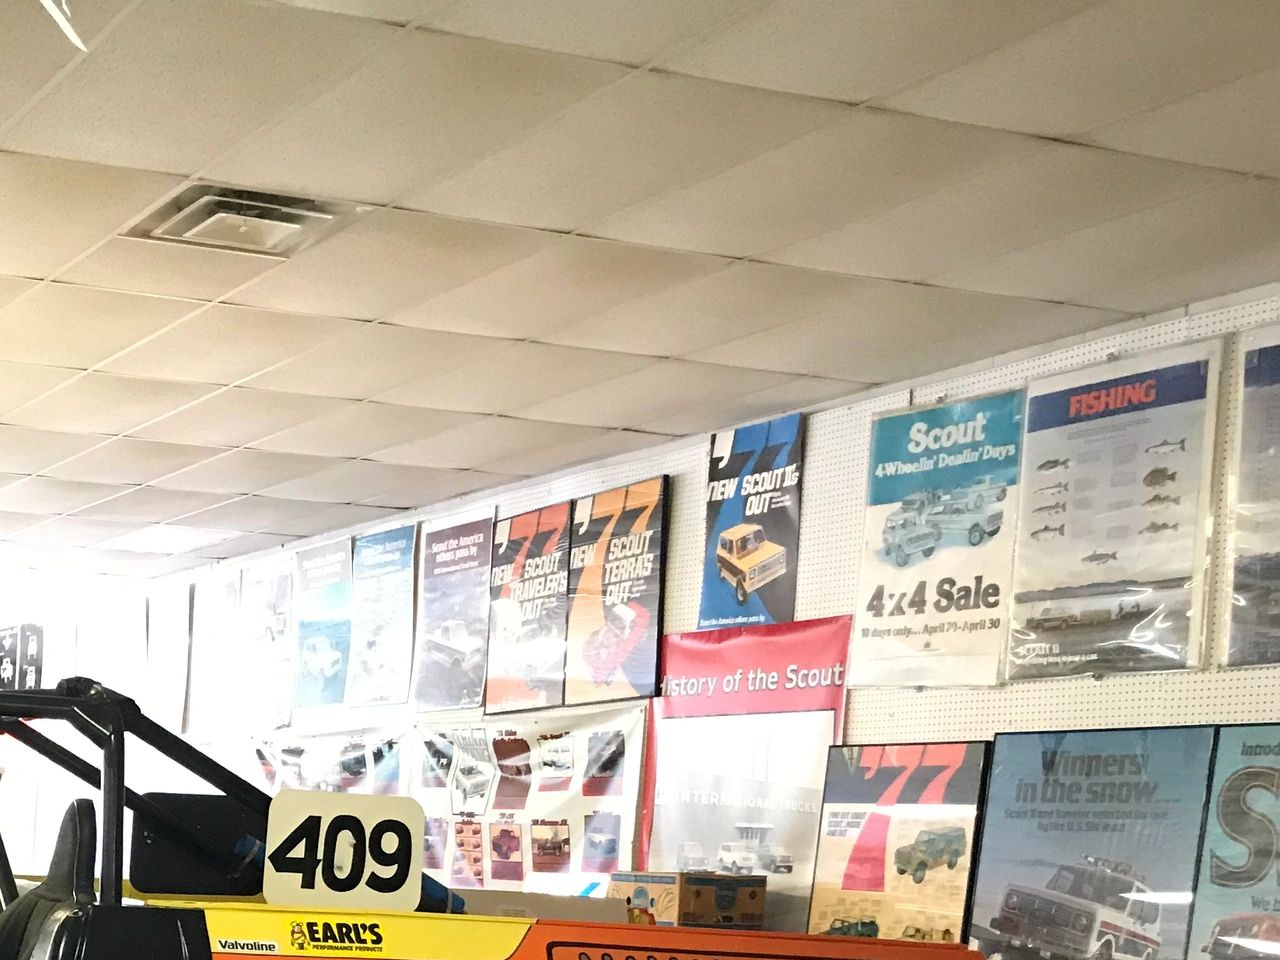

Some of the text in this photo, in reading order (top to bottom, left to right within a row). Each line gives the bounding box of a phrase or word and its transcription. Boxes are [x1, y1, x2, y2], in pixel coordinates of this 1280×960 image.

[1070, 378, 1157, 418] FISHING
[907, 412, 988, 454] Scout
[938, 446, 982, 468] Dealin'
[982, 441, 1016, 464] Days
[741, 469, 785, 496] SCOUT
[745, 495, 772, 517] OUT
[459, 532, 484, 547] America
[469, 545, 478, 557] by
[609, 530, 654, 560] SCOUT
[523, 553, 562, 579] SCOUT
[604, 553, 655, 584] TERRA'S
[509, 569, 569, 600] TRAVELER'S
[605, 582, 632, 606] OUT
[867, 575, 1000, 618] 4x4 Sale
[520, 599, 542, 620] OUT
[871, 626, 891, 639] days
[922, 623, 945, 636] April
[988, 617, 1001, 629] 30
[722, 671, 743, 693] of
[747, 666, 778, 692] the
[784, 661, 843, 690] Scout
[859, 744, 968, 808] '77
[1015, 779, 1038, 803] in
[1041, 778, 1081, 803] the
[267, 814, 412, 893] 409
[1251, 896, 1271, 911] We
[218, 939, 276, 952] Valvoline
[306, 921, 383, 945] EARL'S
[312, 944, 354, 952] PERFORMANCE
